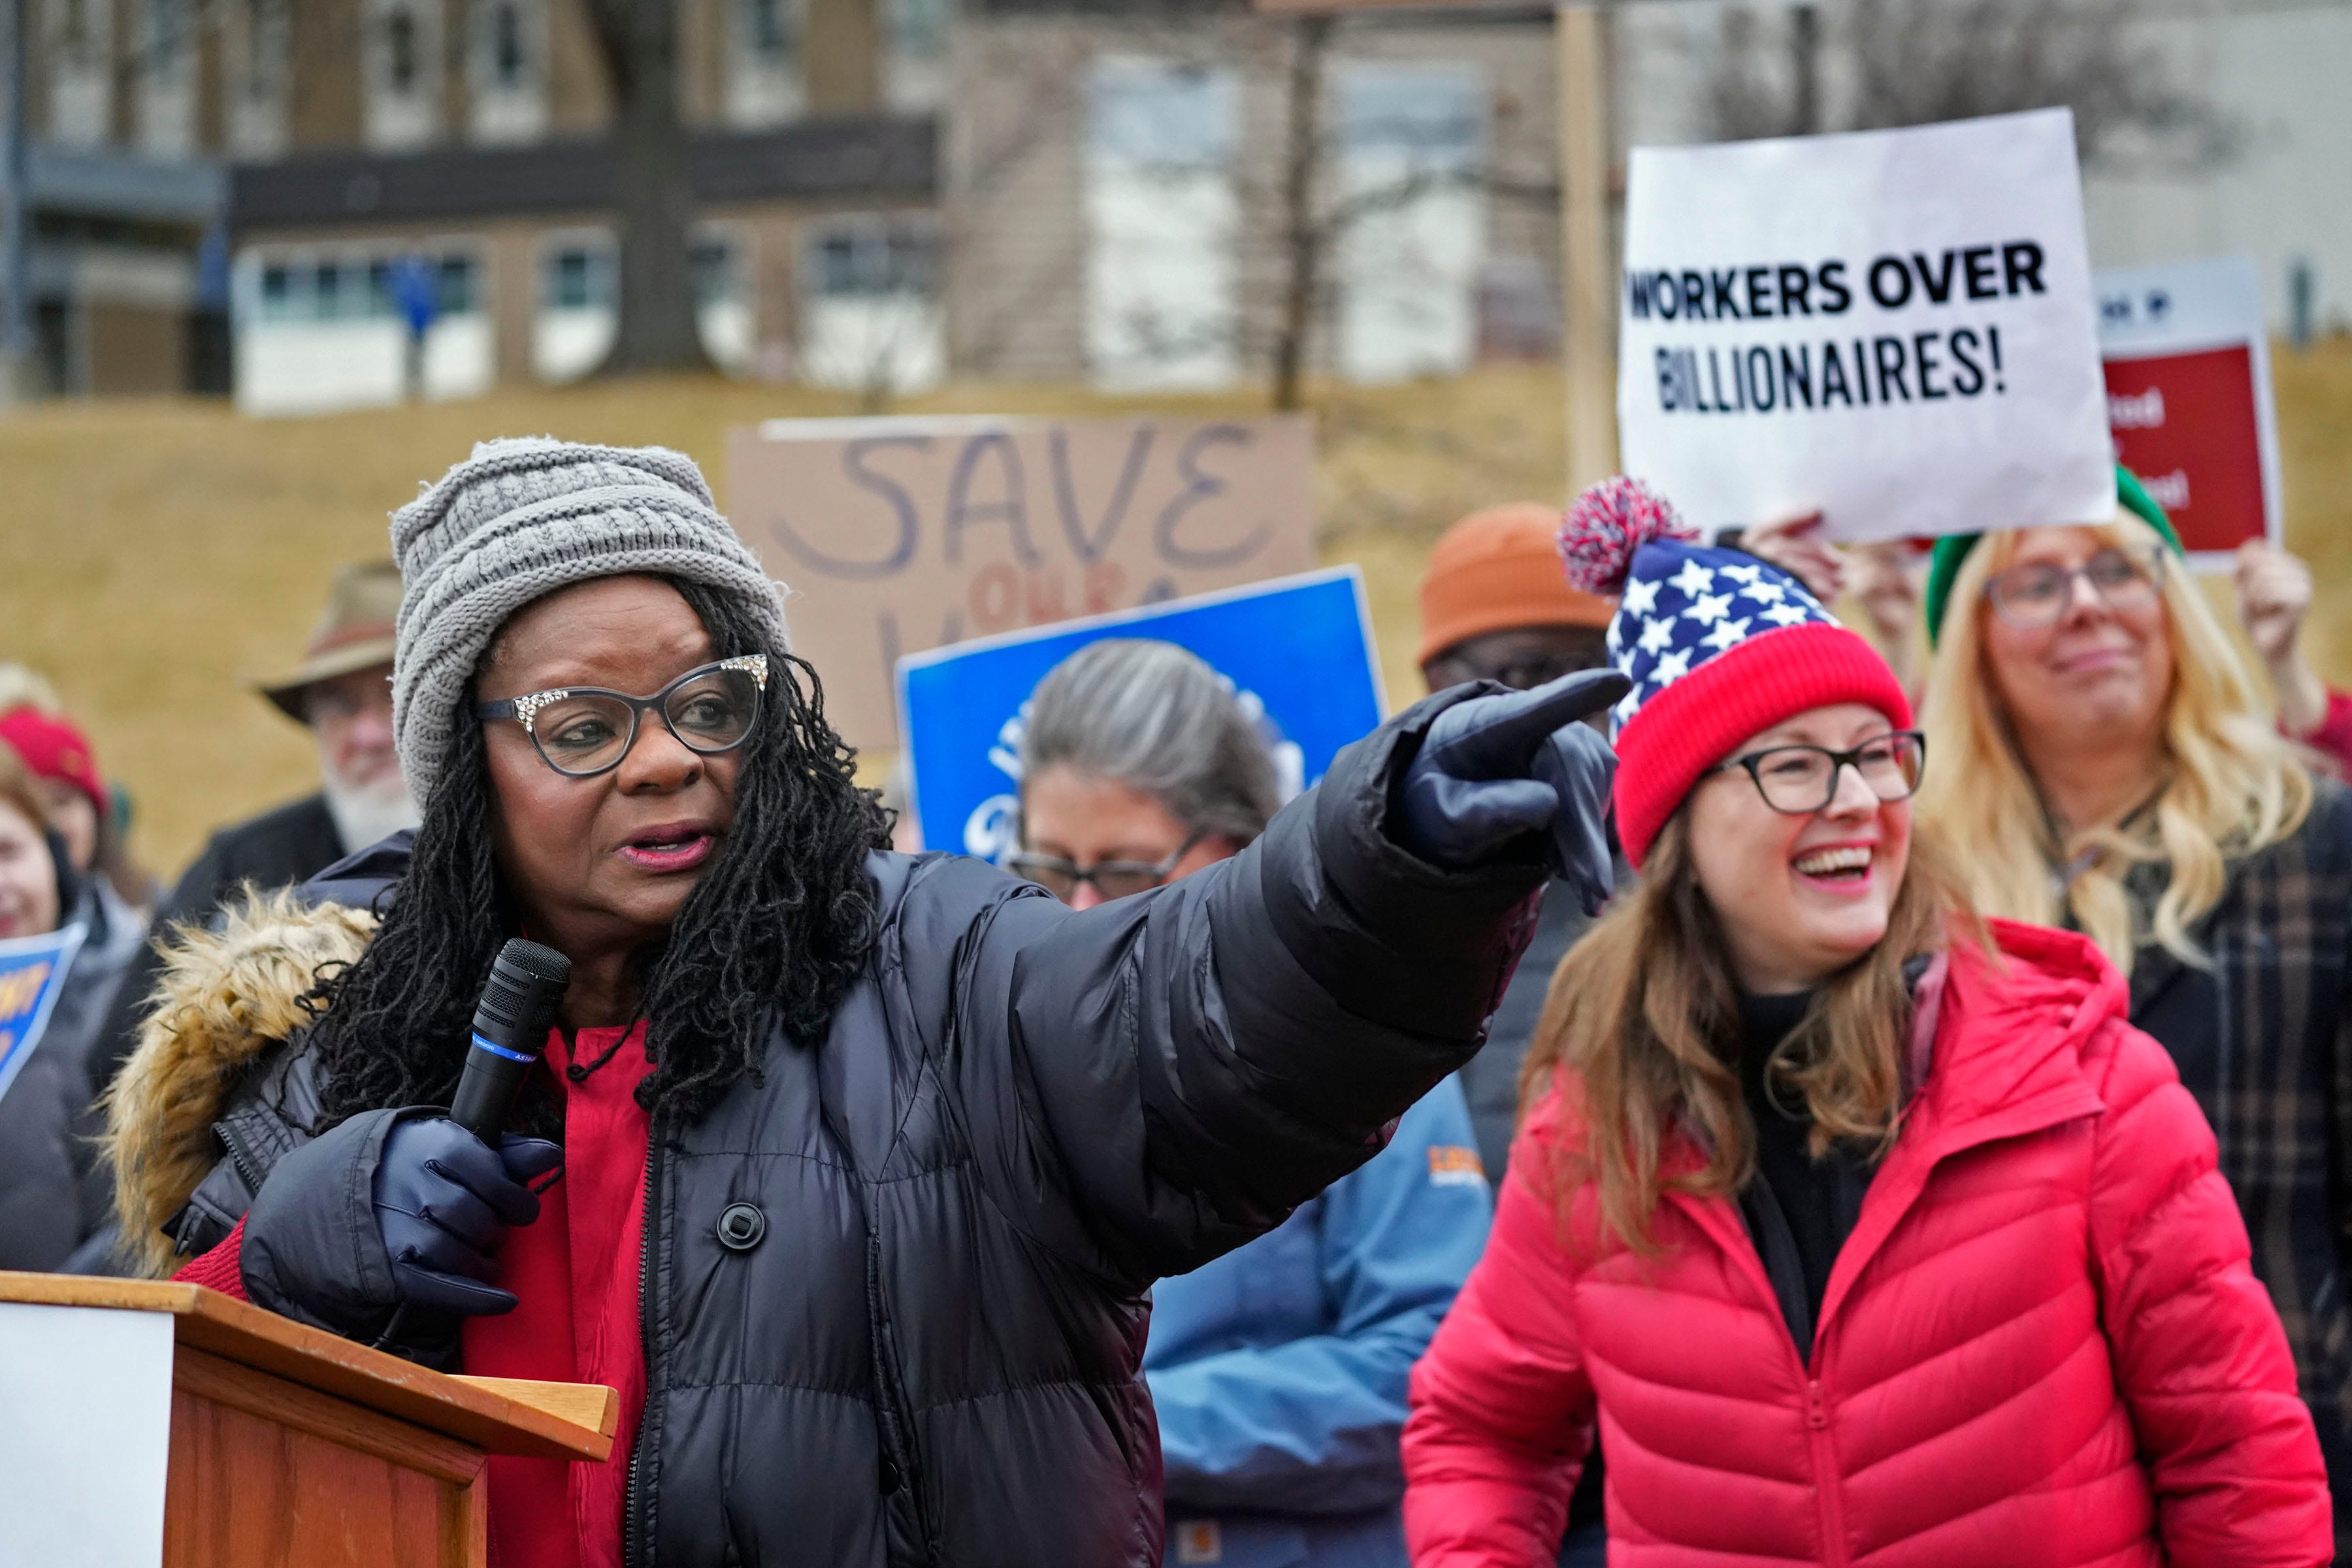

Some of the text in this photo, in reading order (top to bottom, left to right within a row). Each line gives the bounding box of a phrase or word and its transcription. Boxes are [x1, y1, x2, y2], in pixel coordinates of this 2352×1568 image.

[1629, 259, 1852, 319] WORKERS
[1869, 240, 2046, 308] OVER
[1656, 325, 2005, 412] BILLIONAIRES!
[768, 421, 1277, 580] SAVE
